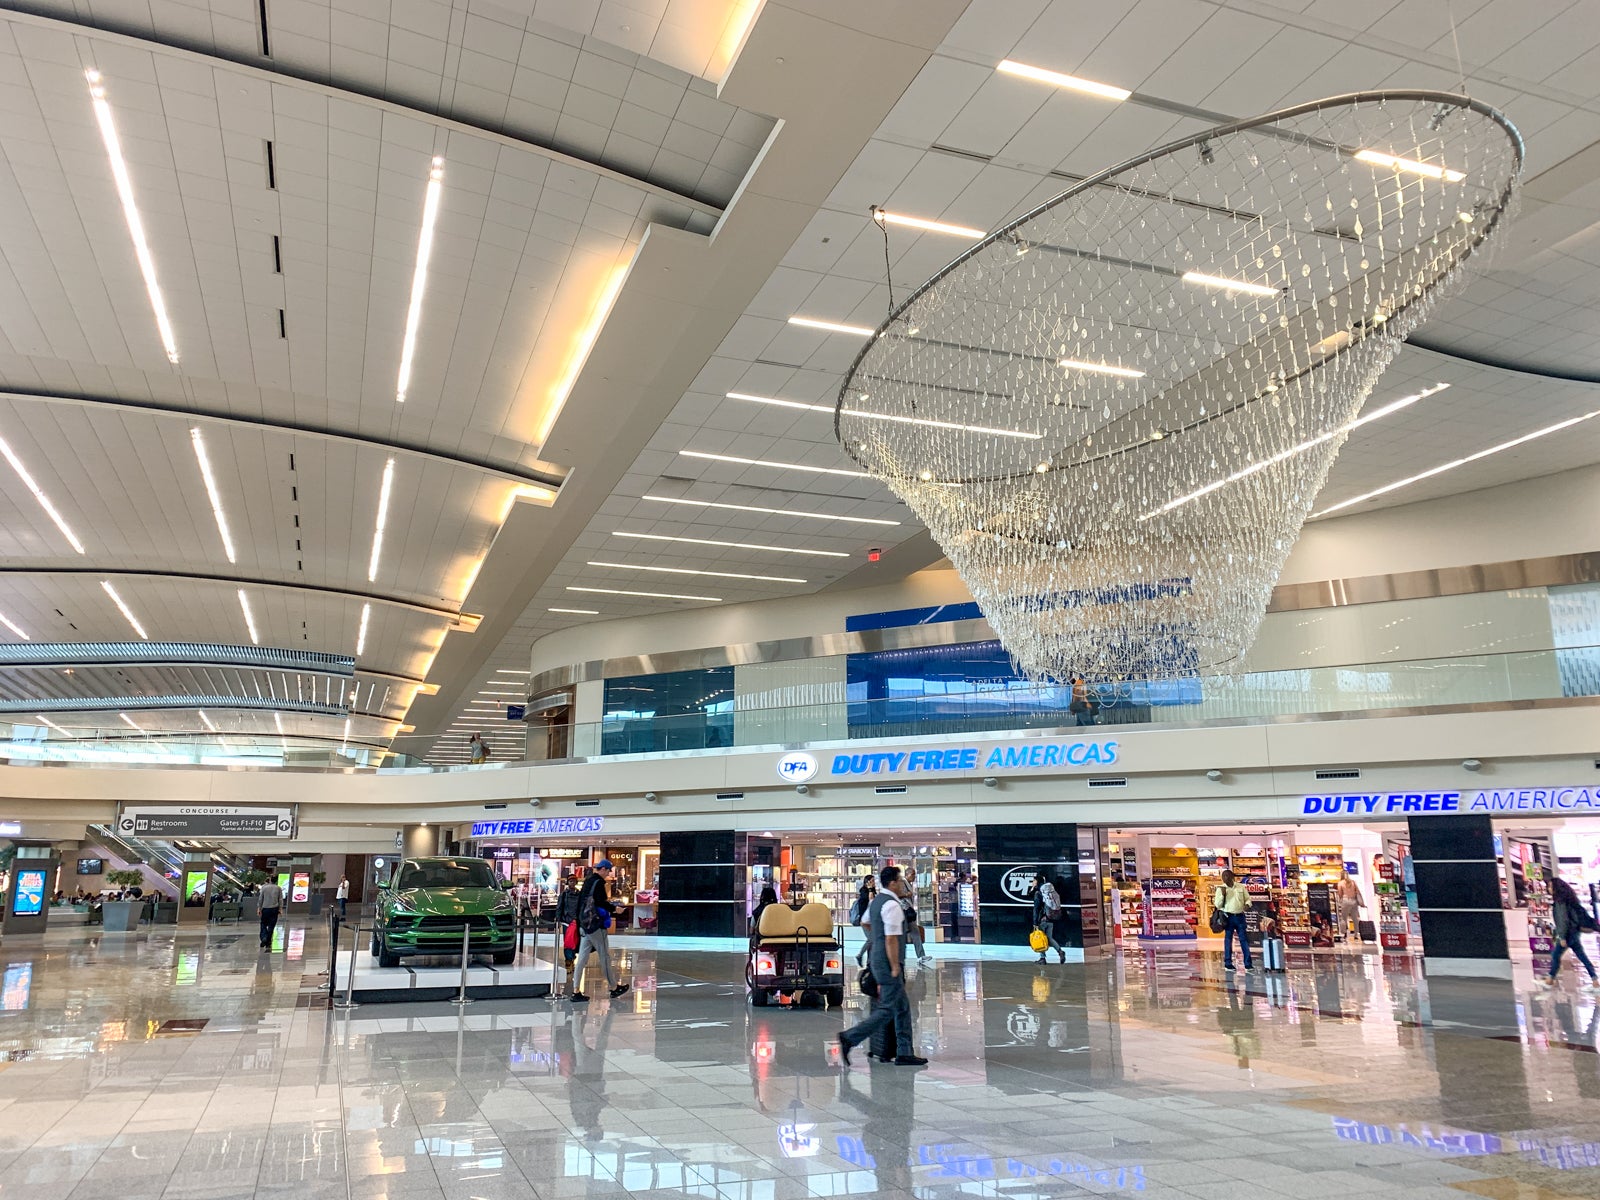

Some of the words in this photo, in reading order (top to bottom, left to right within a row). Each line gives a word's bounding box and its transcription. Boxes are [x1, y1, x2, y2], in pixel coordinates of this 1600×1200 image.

[831, 752, 907, 775] DUTY
[907, 748, 980, 772] FREE
[985, 741, 1120, 768] AMERICAS
[783, 761, 808, 775] DFA
[1303, 795, 1382, 814] DUTY
[1385, 793, 1460, 812] FREE
[150, 819, 188, 827] Restrooms
[220, 819, 240, 827] Gates
[240, 819, 263, 827] F1-F10
[472, 821, 499, 836] DUTY
[500, 820, 534, 835] FREE
[537, 817, 604, 833] AMERICAS
[1009, 877, 1034, 896] DF
